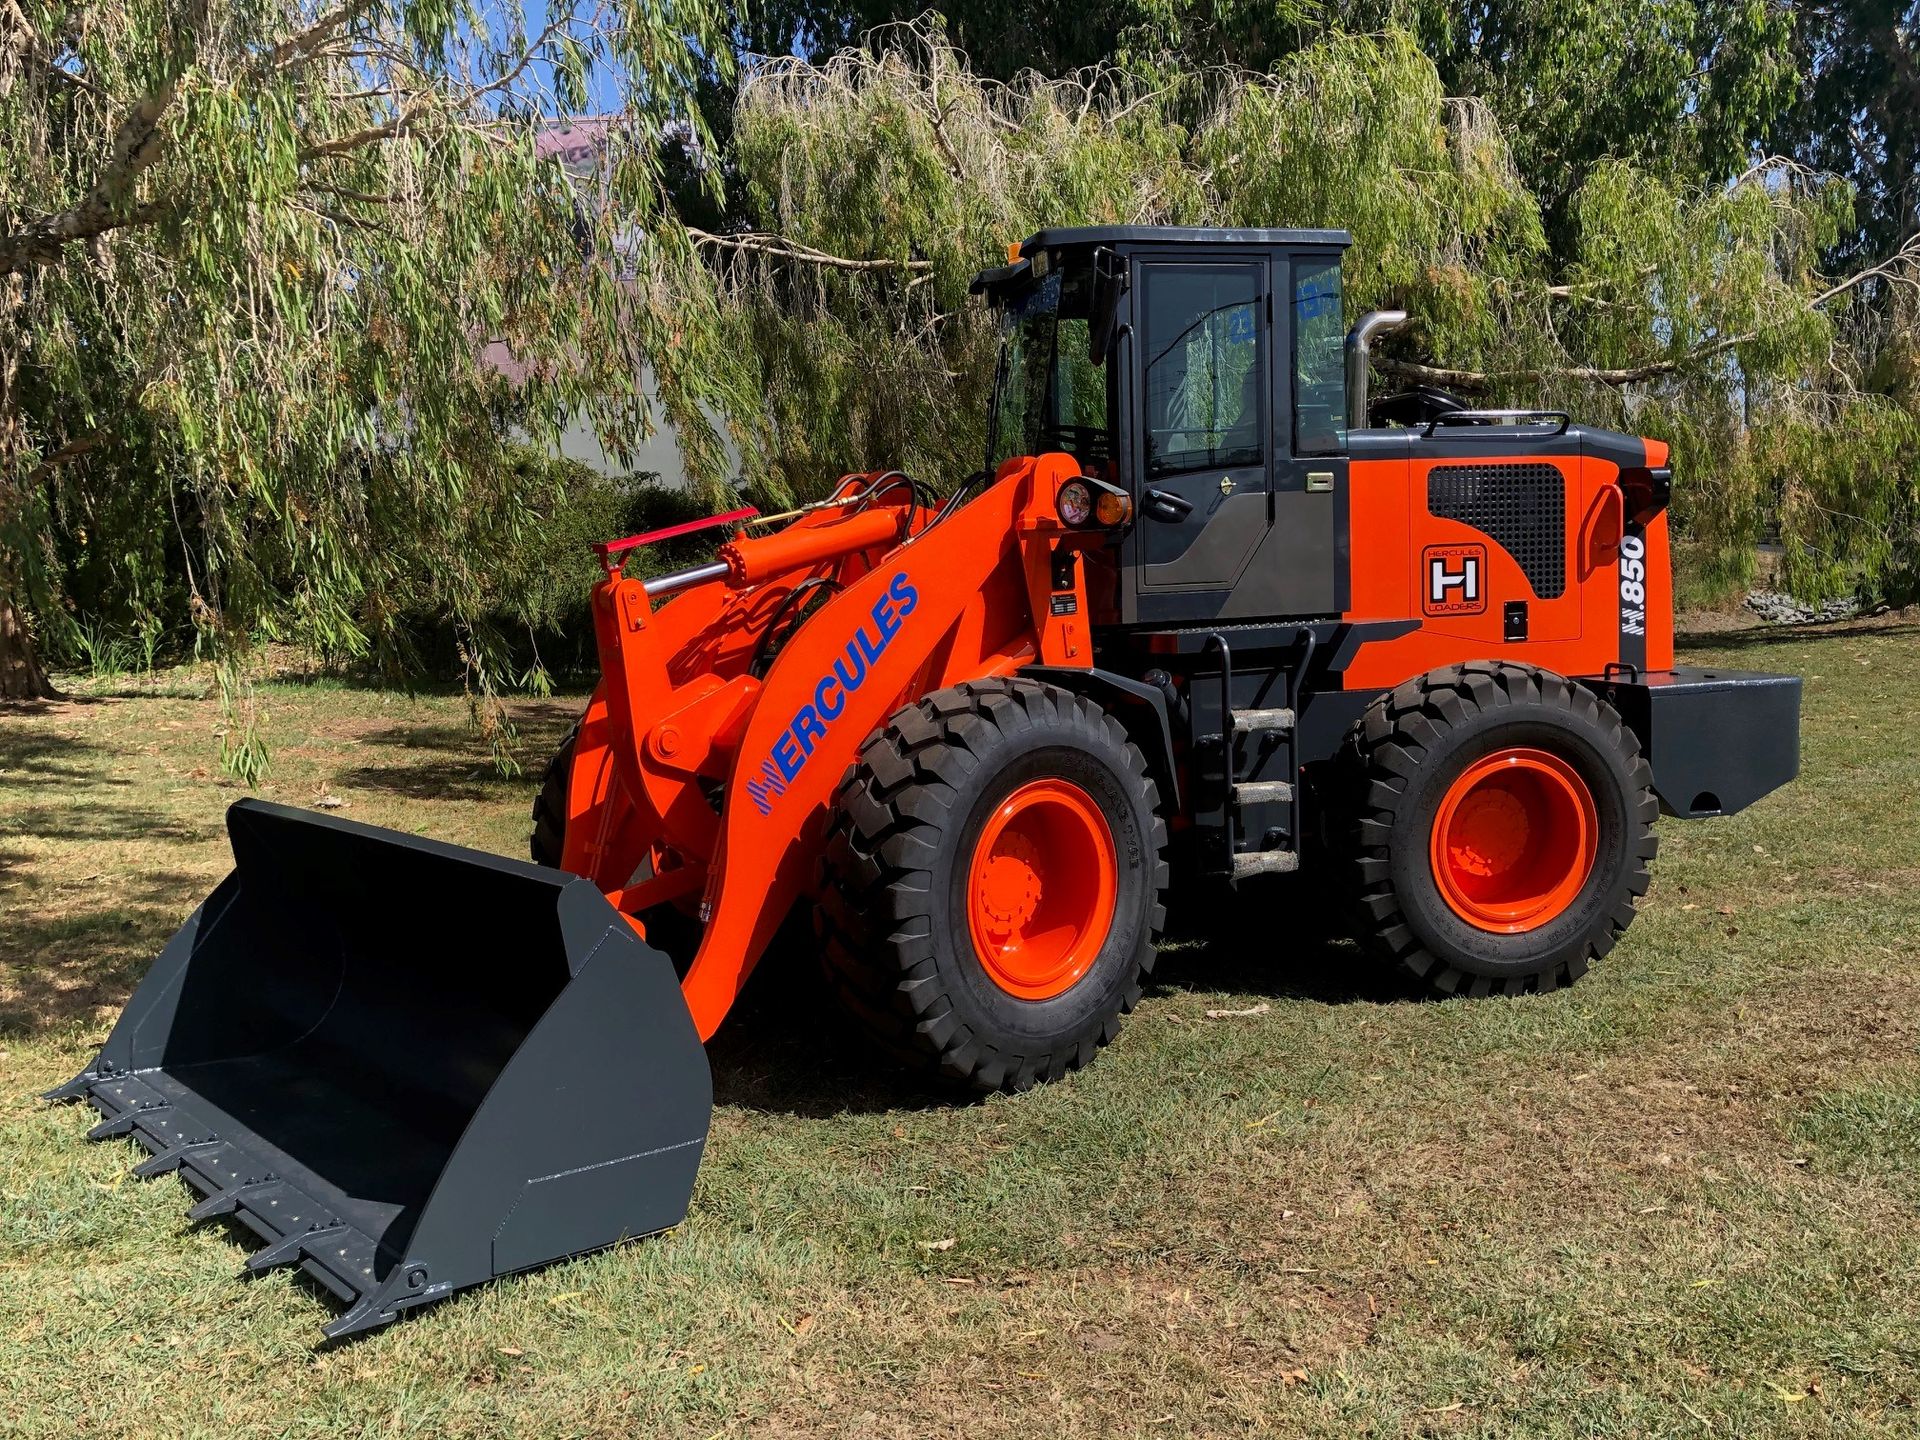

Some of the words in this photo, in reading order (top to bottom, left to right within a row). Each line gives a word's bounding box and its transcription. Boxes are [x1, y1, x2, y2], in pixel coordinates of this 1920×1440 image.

[1428, 549, 1481, 558] HERCULES
[1430, 557, 1480, 603] H
[1428, 602, 1482, 612] LOADERS
[746, 572, 919, 816] HERCULES
